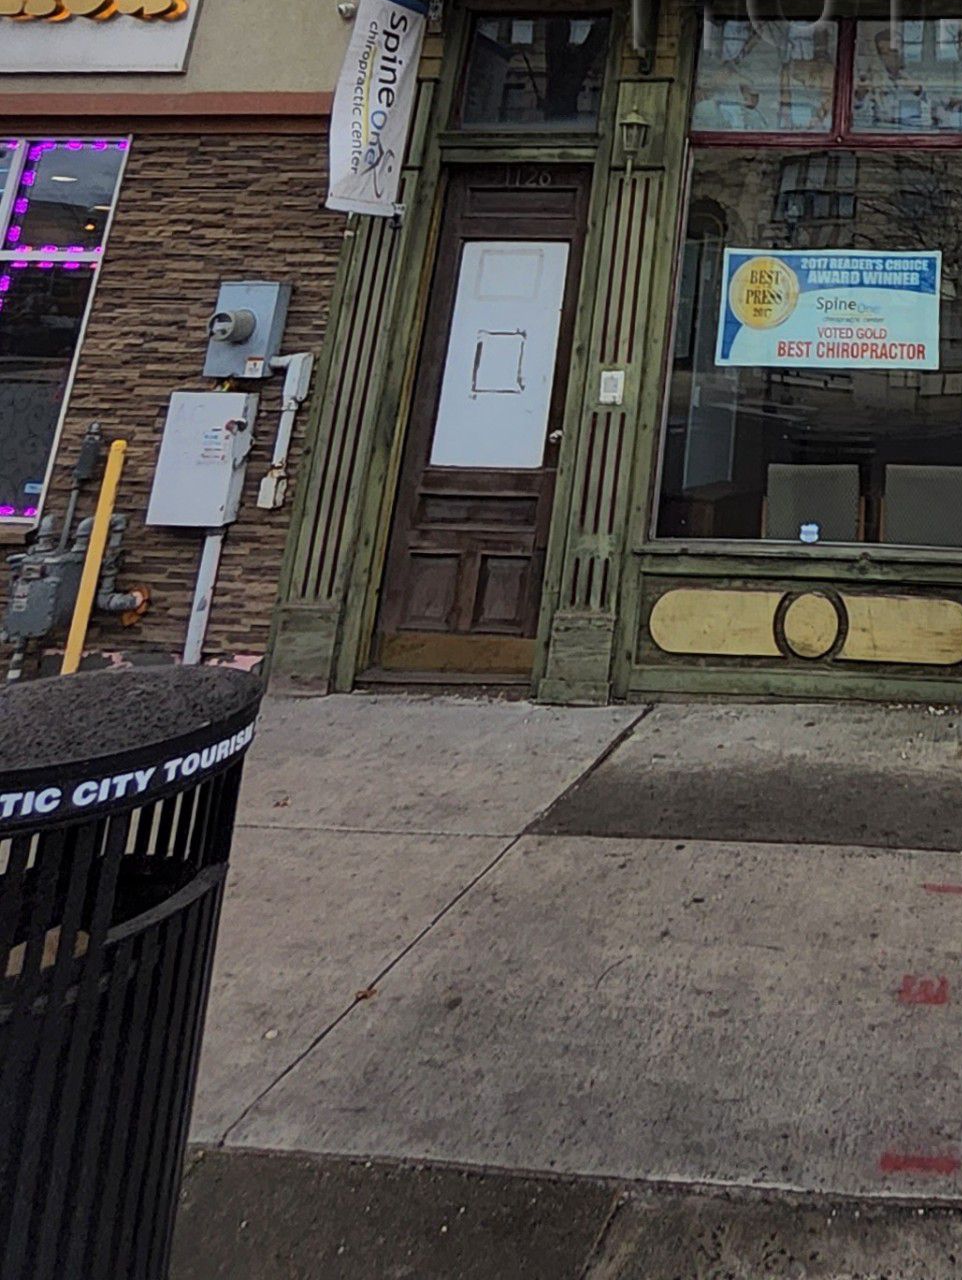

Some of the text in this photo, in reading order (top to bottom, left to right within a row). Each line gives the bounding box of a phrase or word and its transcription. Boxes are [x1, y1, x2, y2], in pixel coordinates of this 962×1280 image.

[378, 11, 408, 108] Spine
[350, 21, 378, 174] chiropractic center
[801, 258, 929, 271] 2017 READER'S CHOICE
[750, 269, 781, 285] BEST
[807, 271, 920, 286] AWARD WINNER
[745, 289, 784, 305] PRESS
[816, 296, 857, 313] Spine
[818, 327, 887, 339] VOTED GOLD
[778, 341, 925, 360] BEST CHIROPRACTOR
[71, 767, 157, 806] CITY
